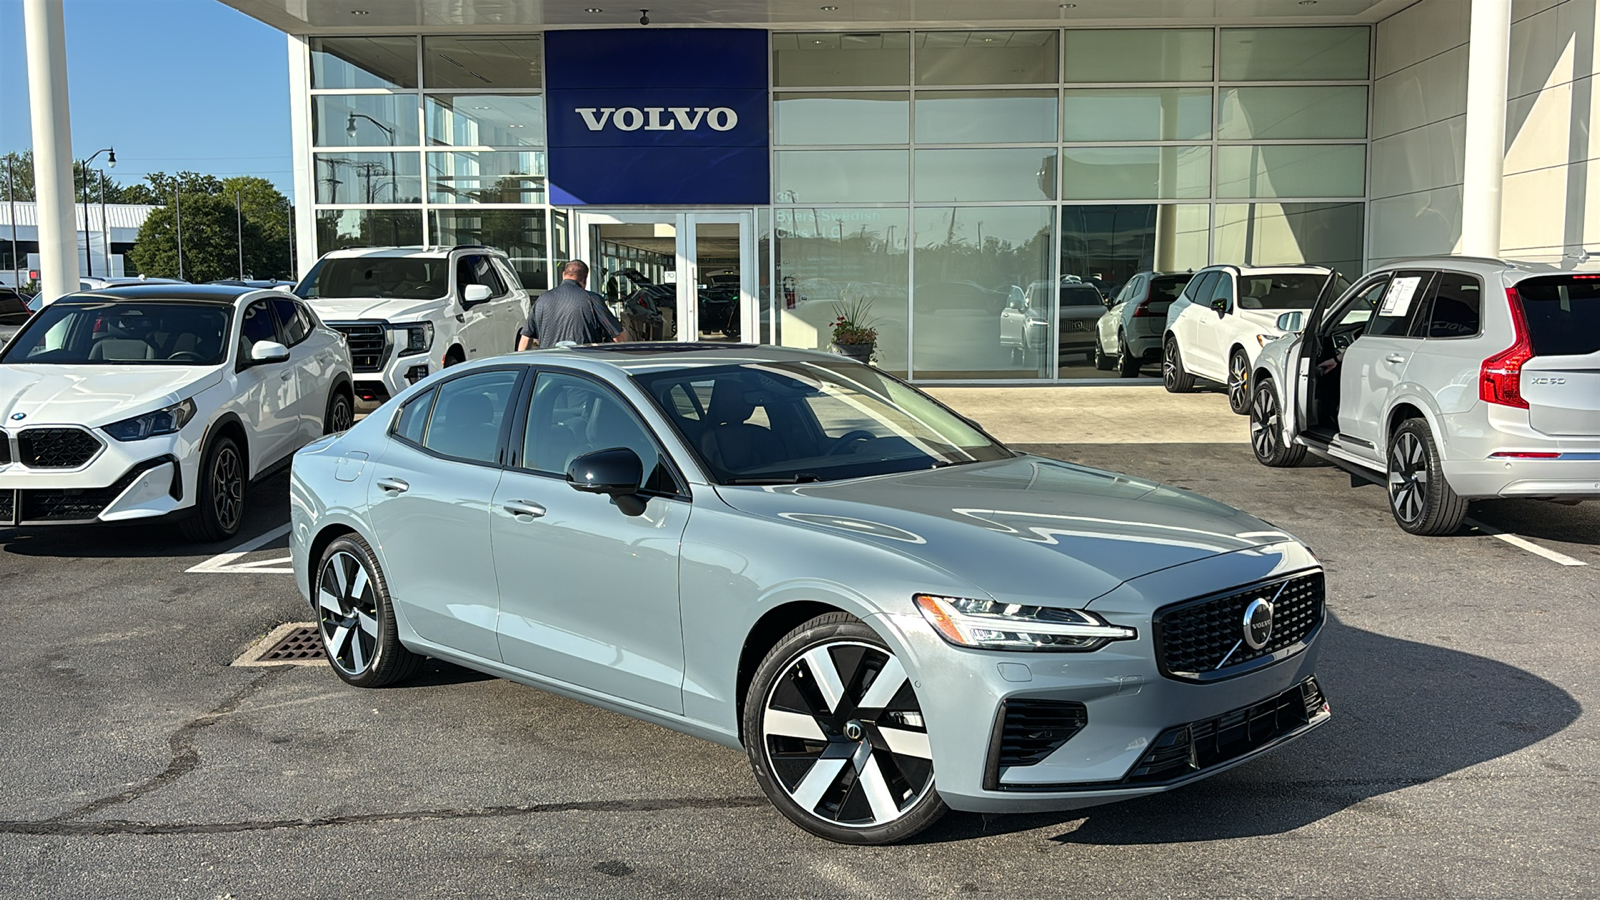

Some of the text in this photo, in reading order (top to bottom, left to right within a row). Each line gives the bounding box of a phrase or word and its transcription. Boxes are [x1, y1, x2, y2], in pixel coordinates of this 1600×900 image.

[575, 107, 738, 131] VOLVO
[776, 210, 880, 224] Byers Swedish
